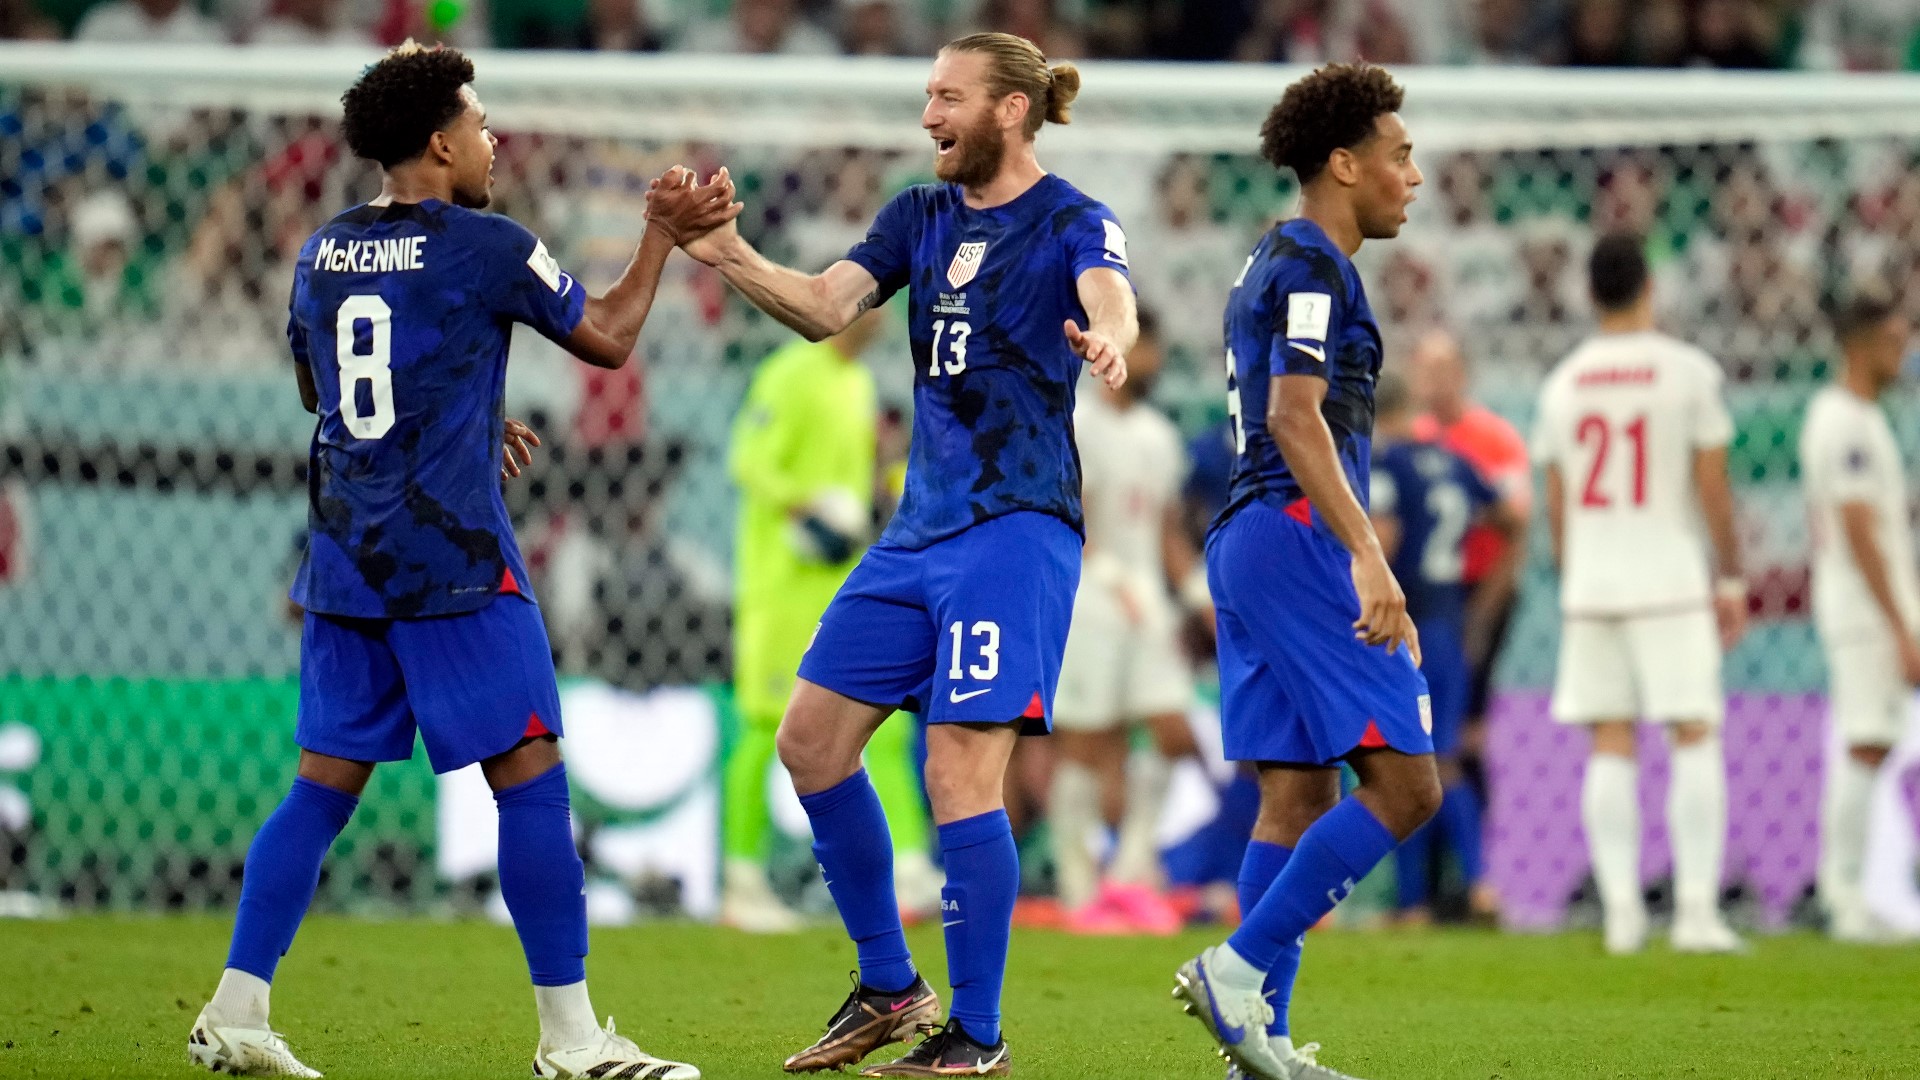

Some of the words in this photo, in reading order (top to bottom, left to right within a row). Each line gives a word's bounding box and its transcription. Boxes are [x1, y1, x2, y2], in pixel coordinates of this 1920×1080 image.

[314, 235, 427, 273] McKENNIE
[958, 244, 984, 263] USA
[336, 294, 396, 440] 8
[929, 319, 972, 377] 13
[1576, 411, 1647, 509] 21
[1421, 481, 1467, 582] 2
[949, 620, 1000, 681] 13
[940, 899, 960, 912] SA
